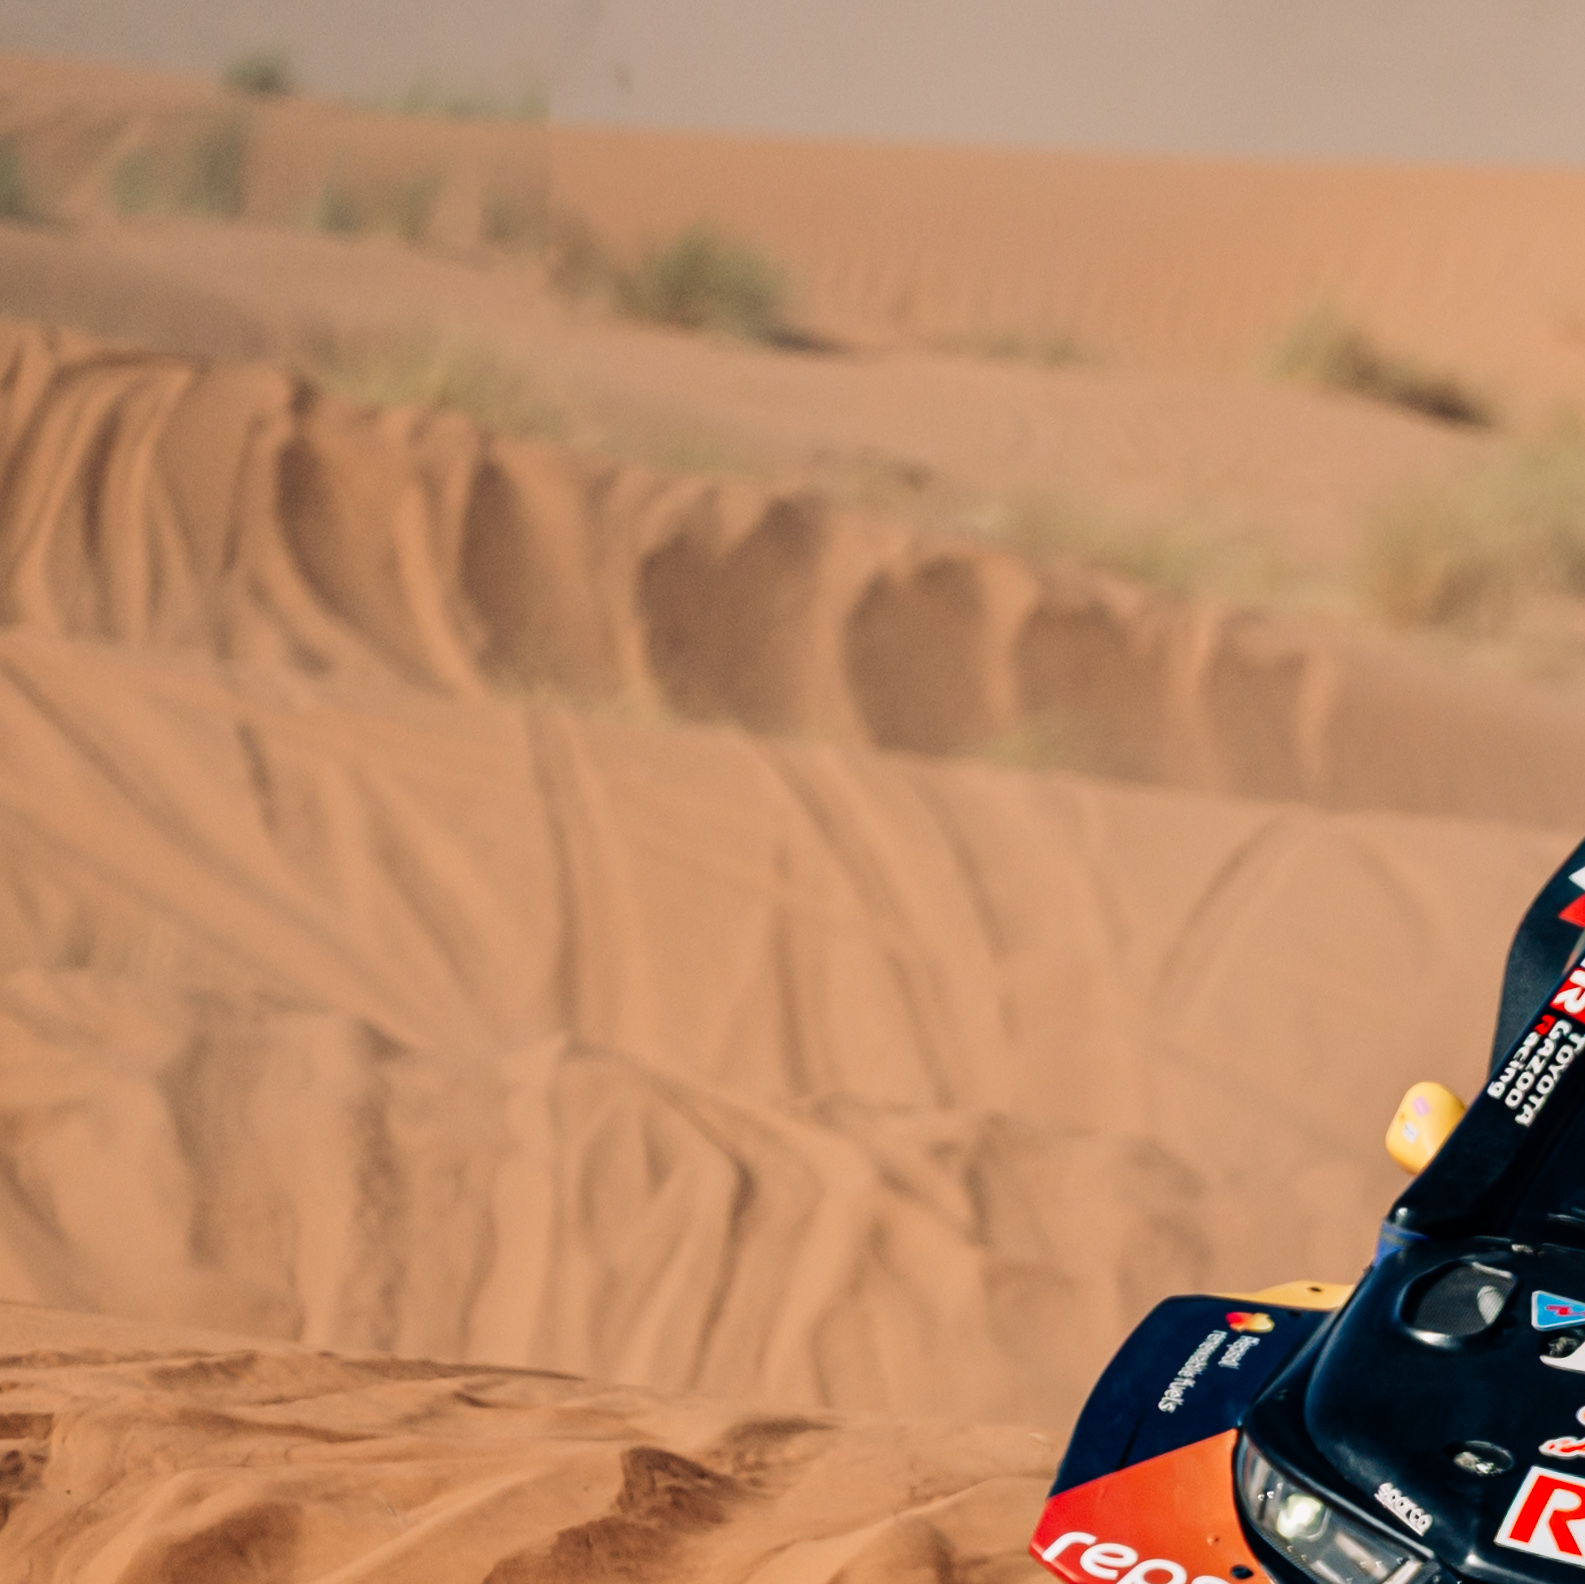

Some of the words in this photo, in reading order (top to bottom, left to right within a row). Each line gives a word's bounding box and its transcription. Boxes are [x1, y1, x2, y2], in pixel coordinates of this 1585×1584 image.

[1504, 1019, 1573, 1110] GAZOO
[1217, 1334, 1261, 1370] Repsol
[1374, 1481, 1433, 1537] sparco
